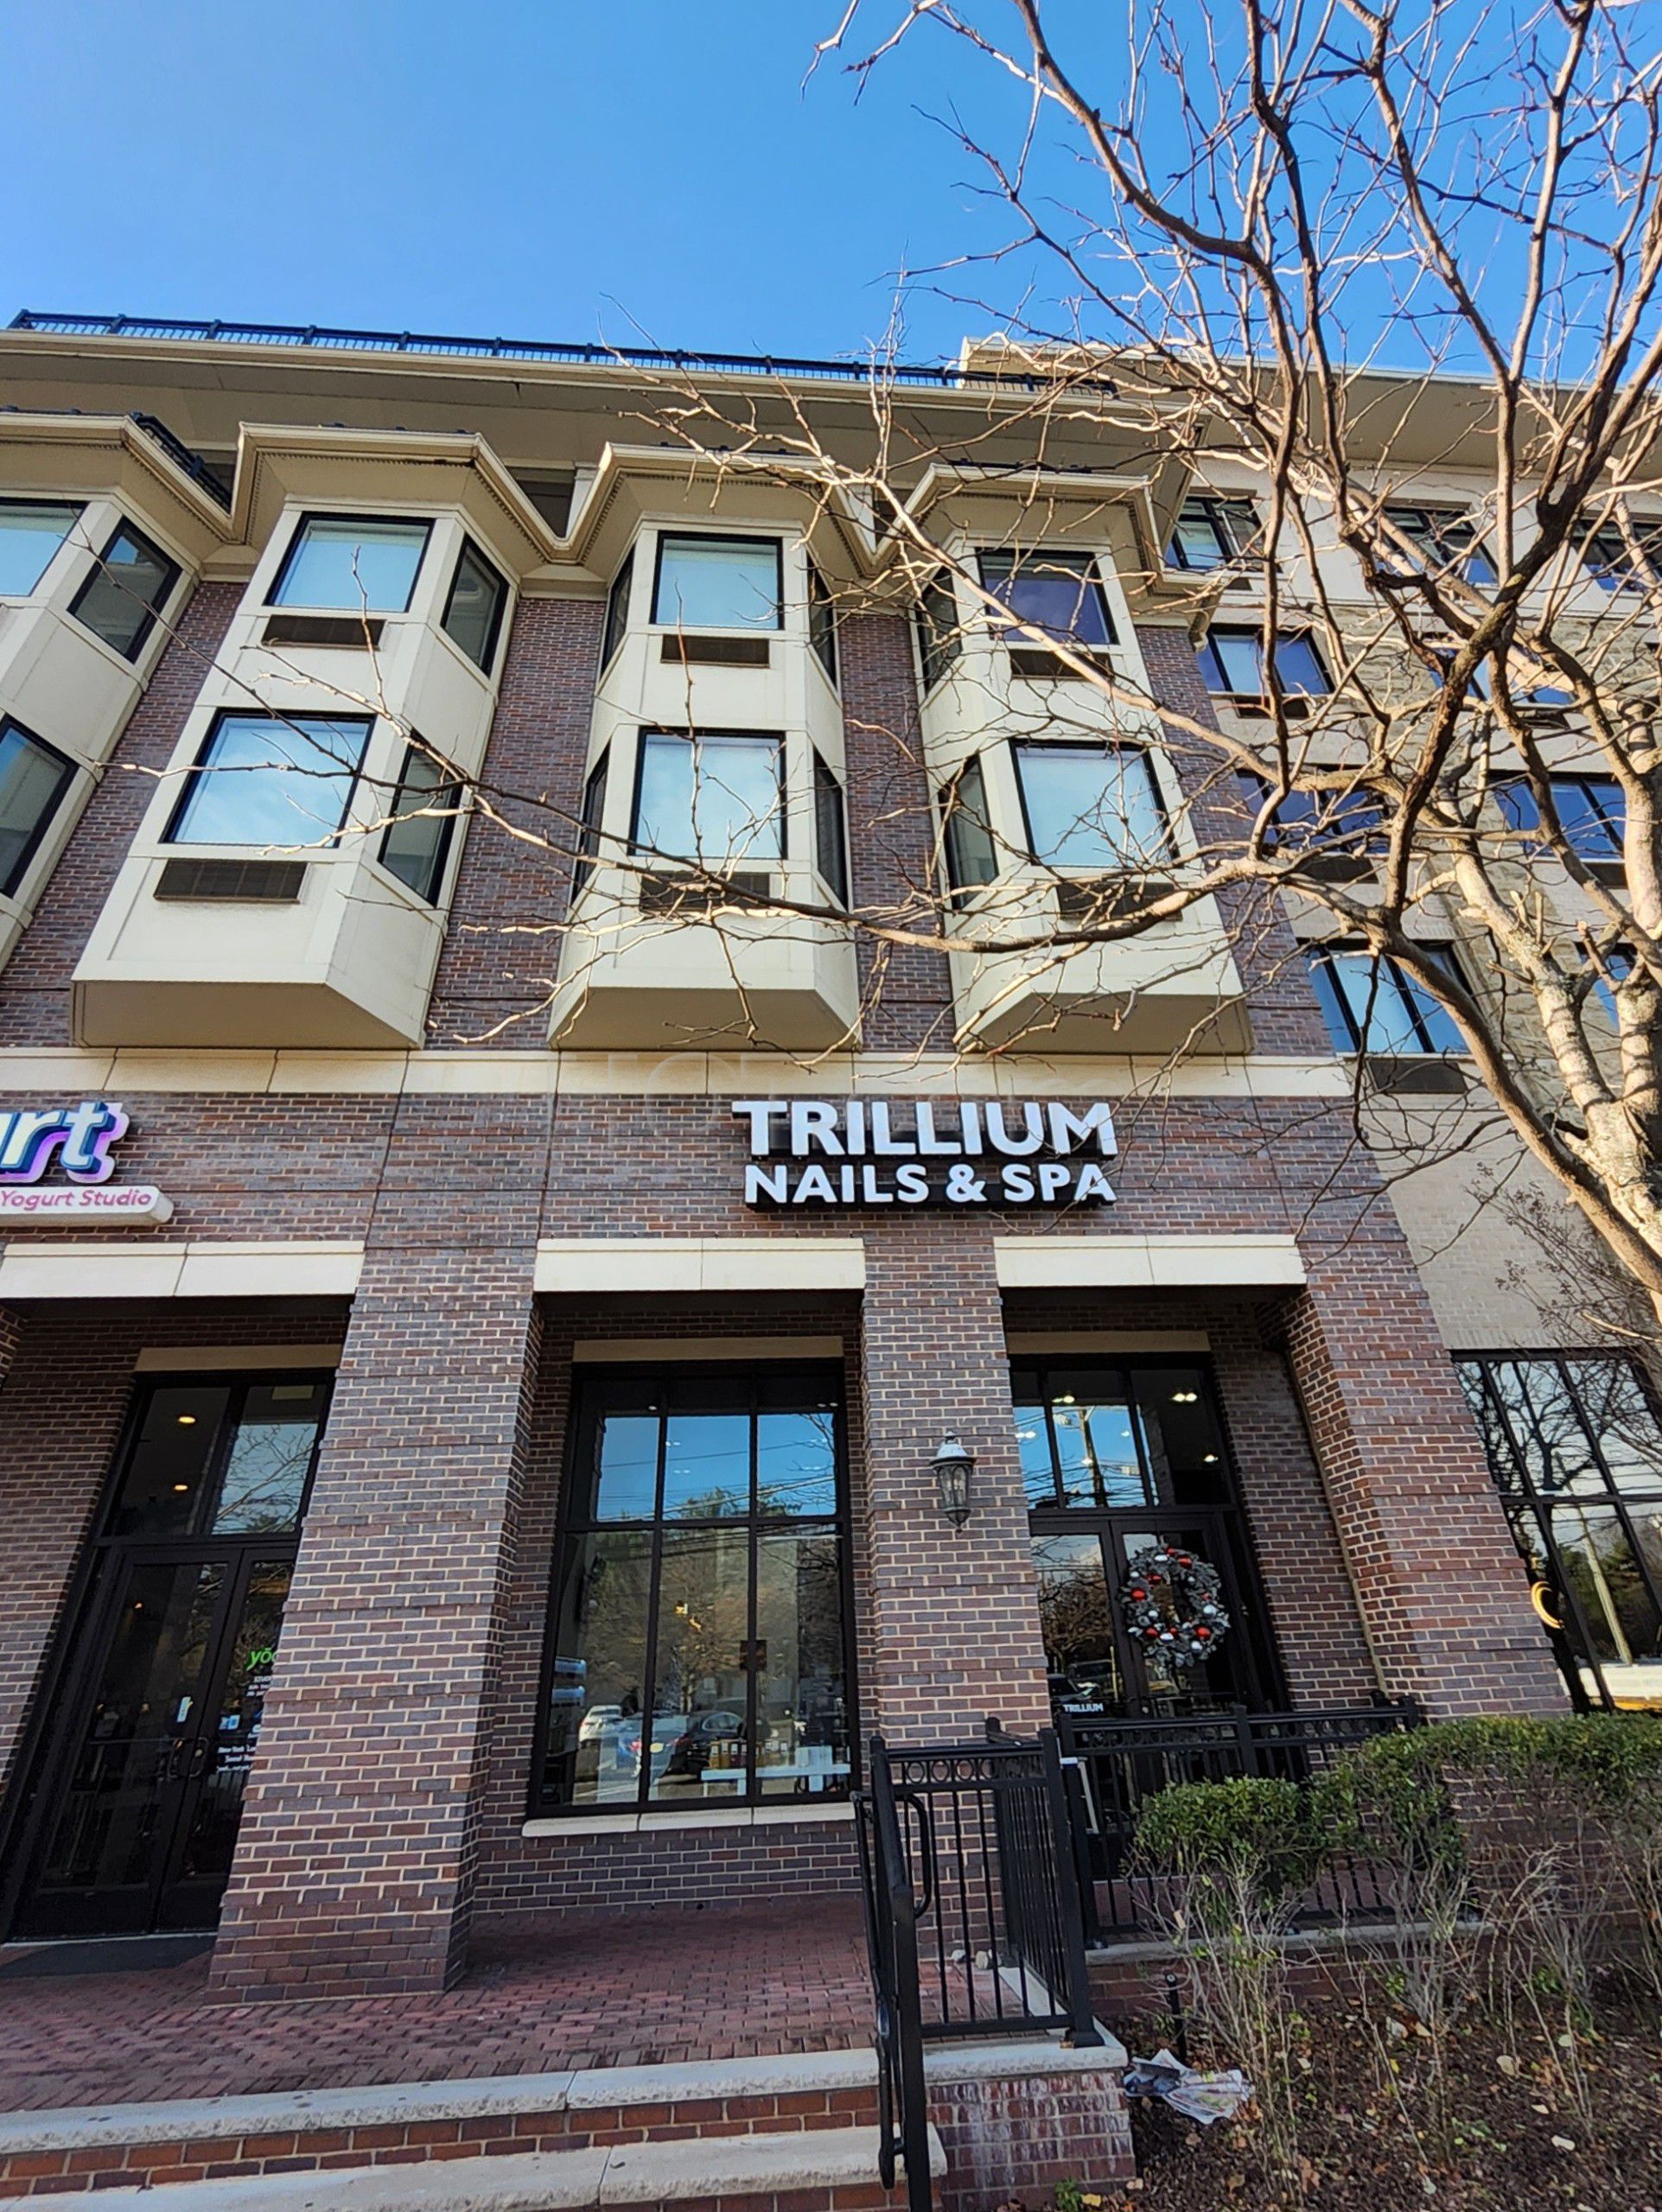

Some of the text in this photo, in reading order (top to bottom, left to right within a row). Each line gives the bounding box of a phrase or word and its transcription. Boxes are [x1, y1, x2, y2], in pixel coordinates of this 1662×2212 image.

[731, 1100, 1118, 1156] TRILLIUM
[0, 1188, 152, 1211] Yogurt Studio
[745, 1163, 1118, 1204] NAILS & SPA
